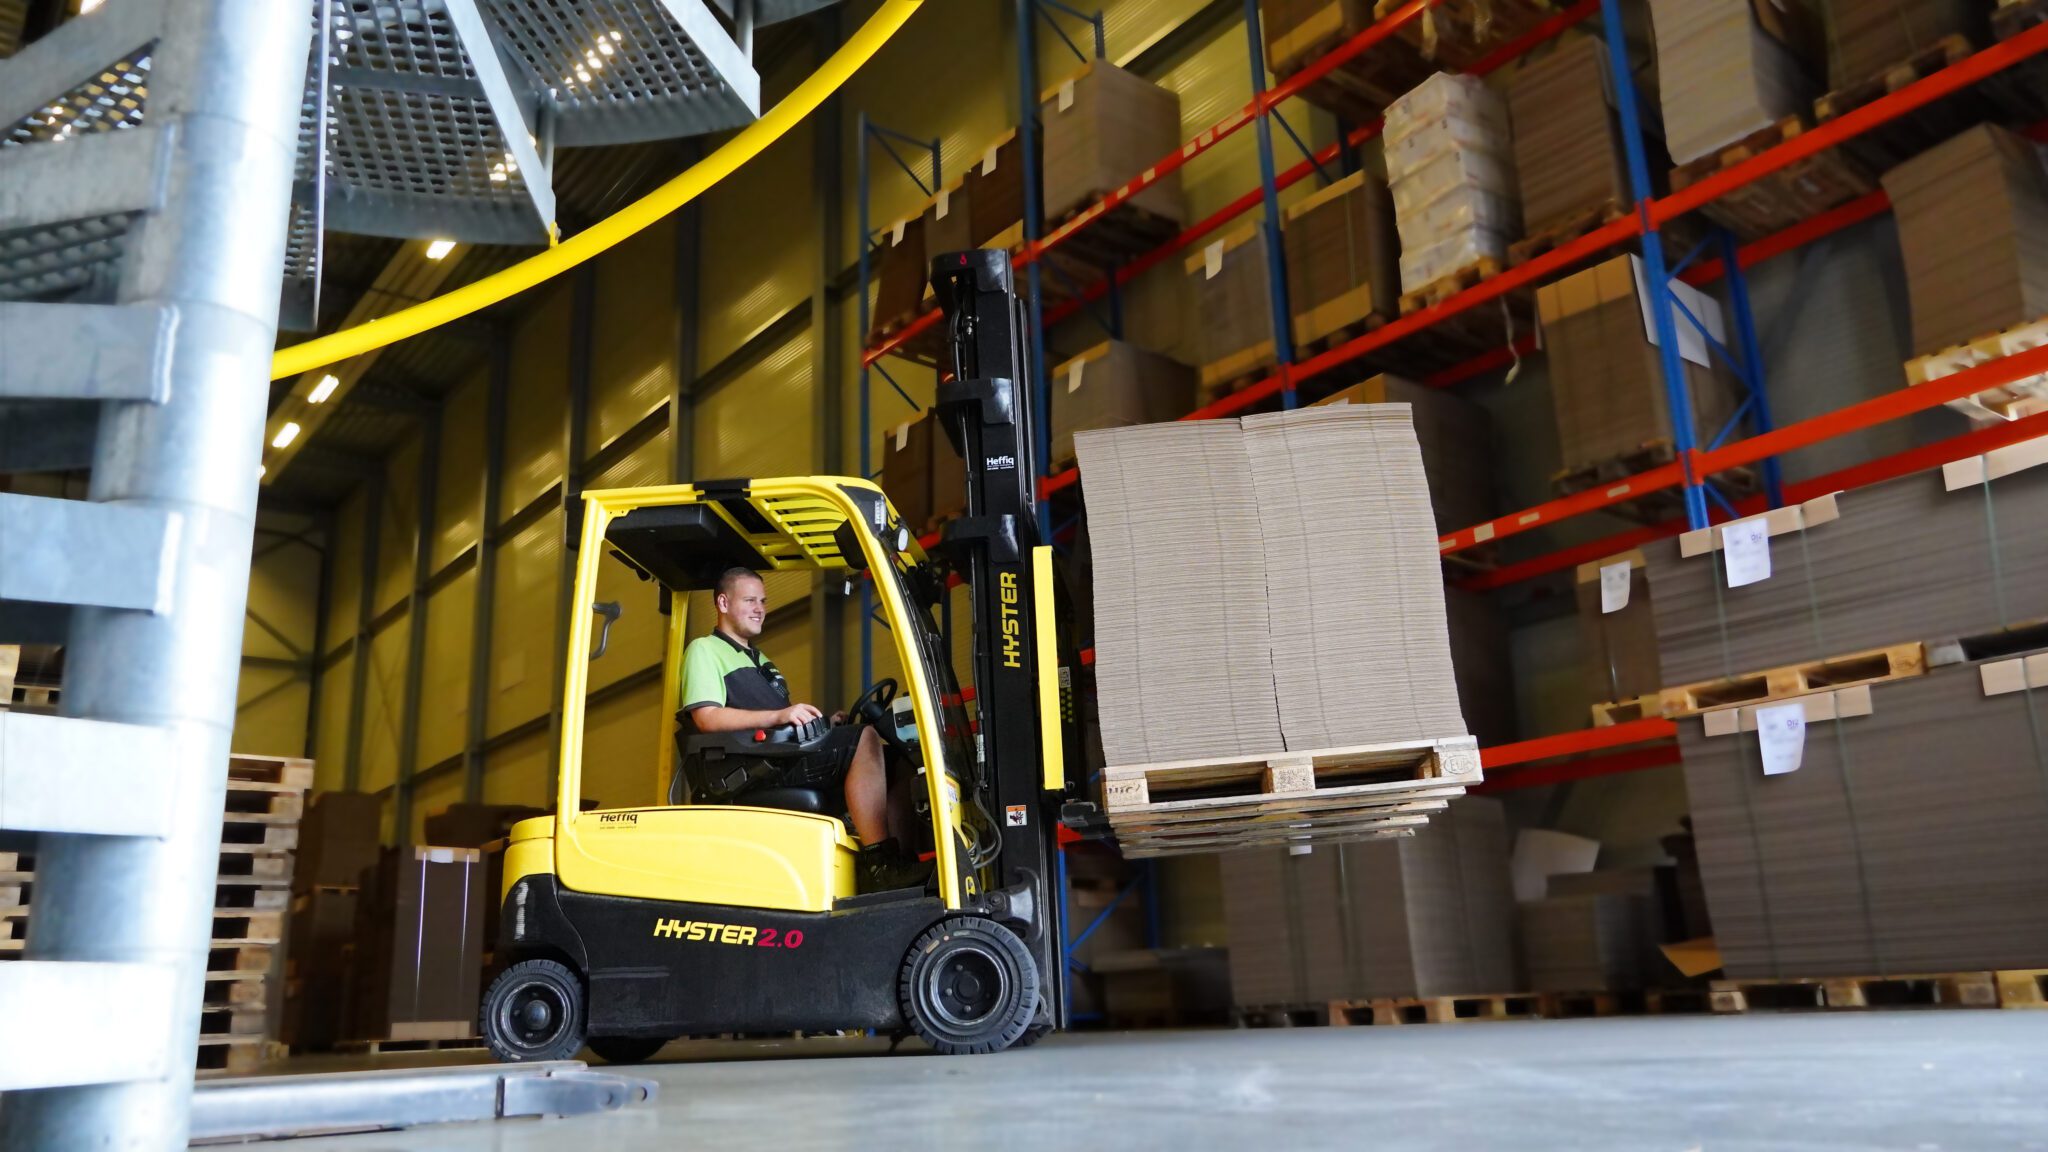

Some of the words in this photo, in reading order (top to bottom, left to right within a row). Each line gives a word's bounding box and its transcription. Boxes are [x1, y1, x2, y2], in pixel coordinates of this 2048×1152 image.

[986, 456, 1014, 466] Heffiq
[1000, 572, 1020, 668] HYSTER
[653, 918, 757, 946] HYSTER
[757, 928, 804, 949] 2.0
